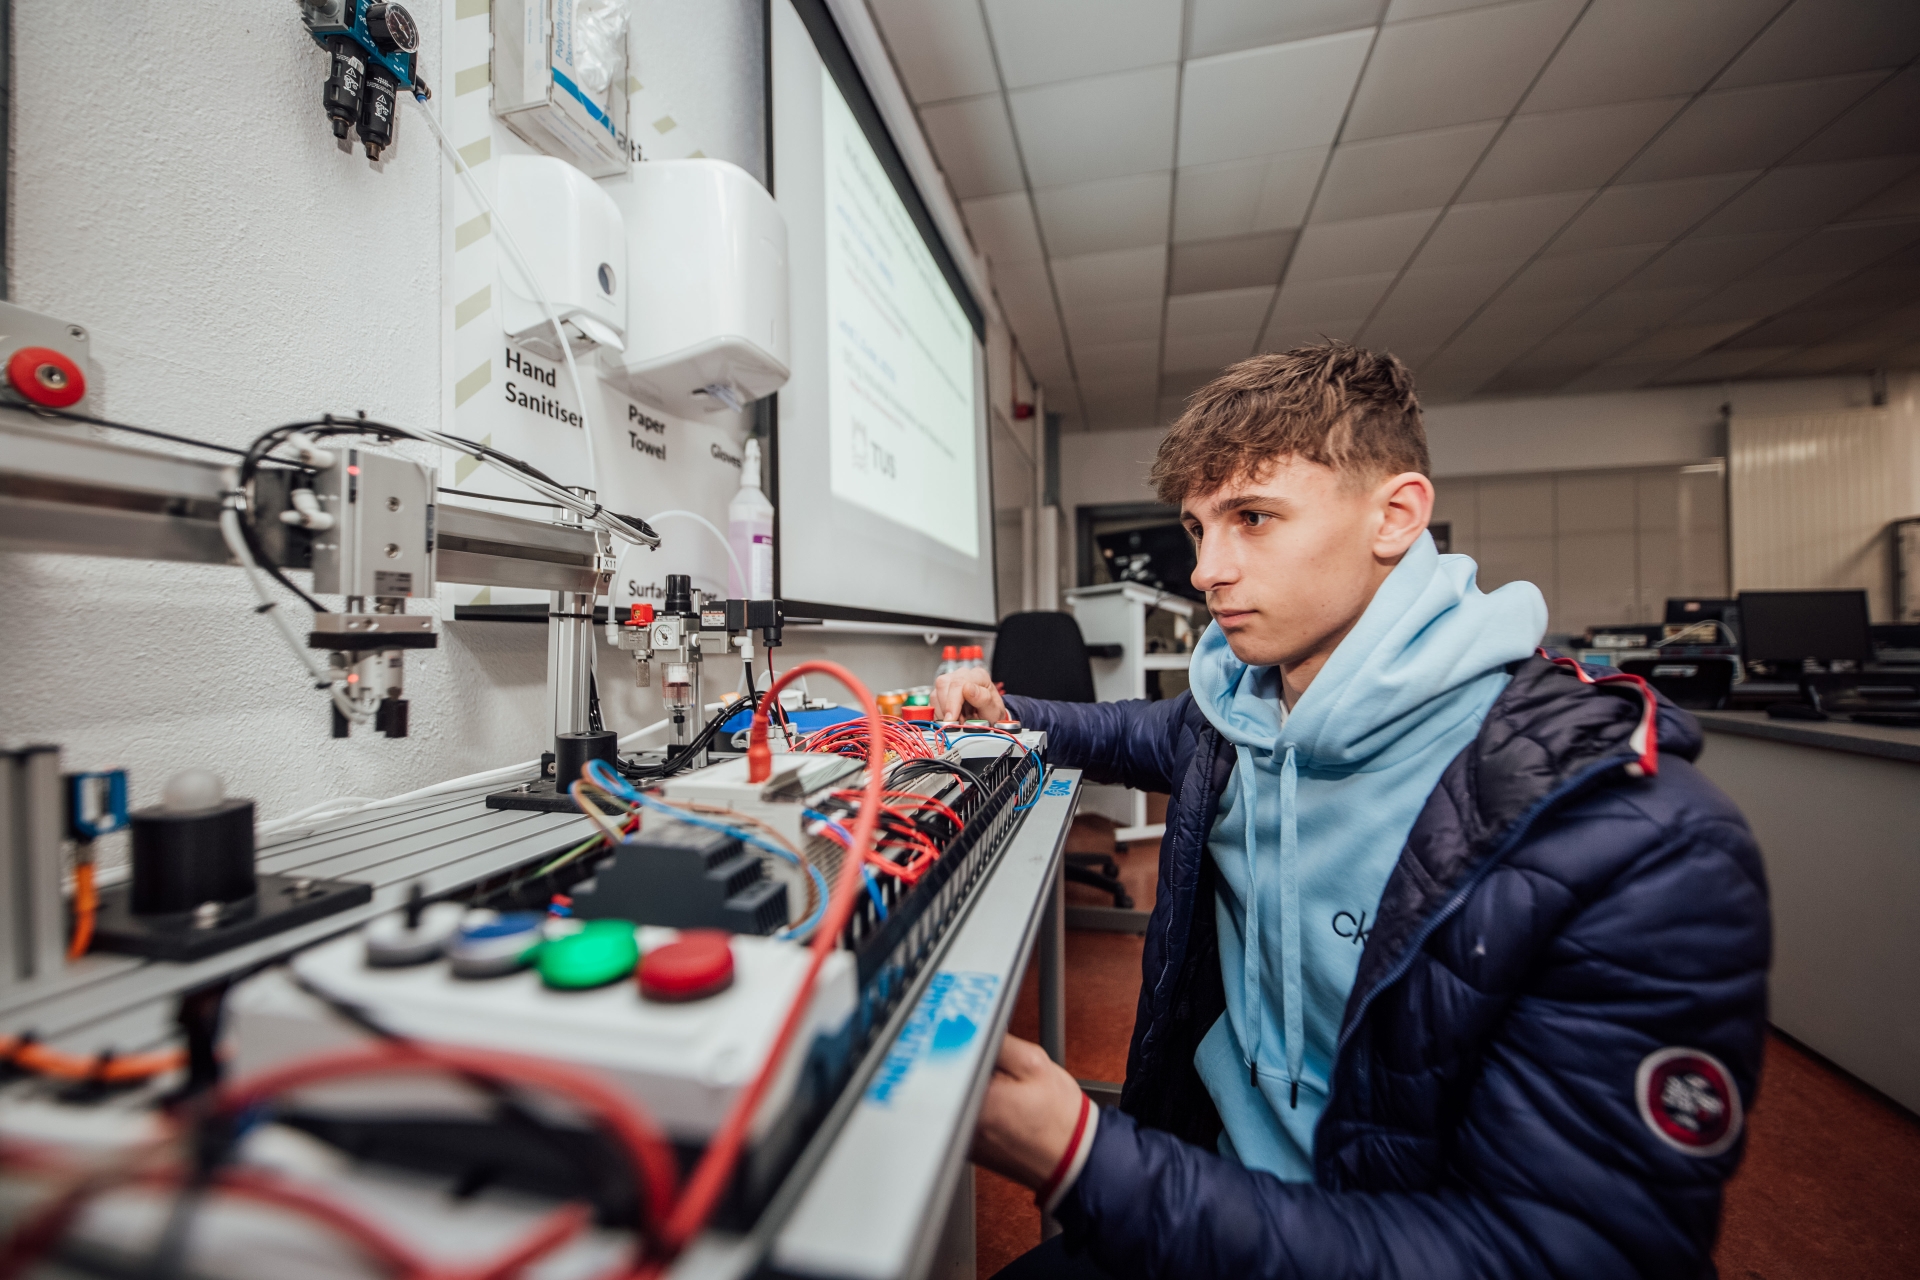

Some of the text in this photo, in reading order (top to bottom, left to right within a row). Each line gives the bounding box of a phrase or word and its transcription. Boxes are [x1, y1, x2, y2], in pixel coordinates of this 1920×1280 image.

[505, 347, 556, 388] Hand
[628, 403, 666, 435] Paper
[628, 430, 667, 461] Towel
